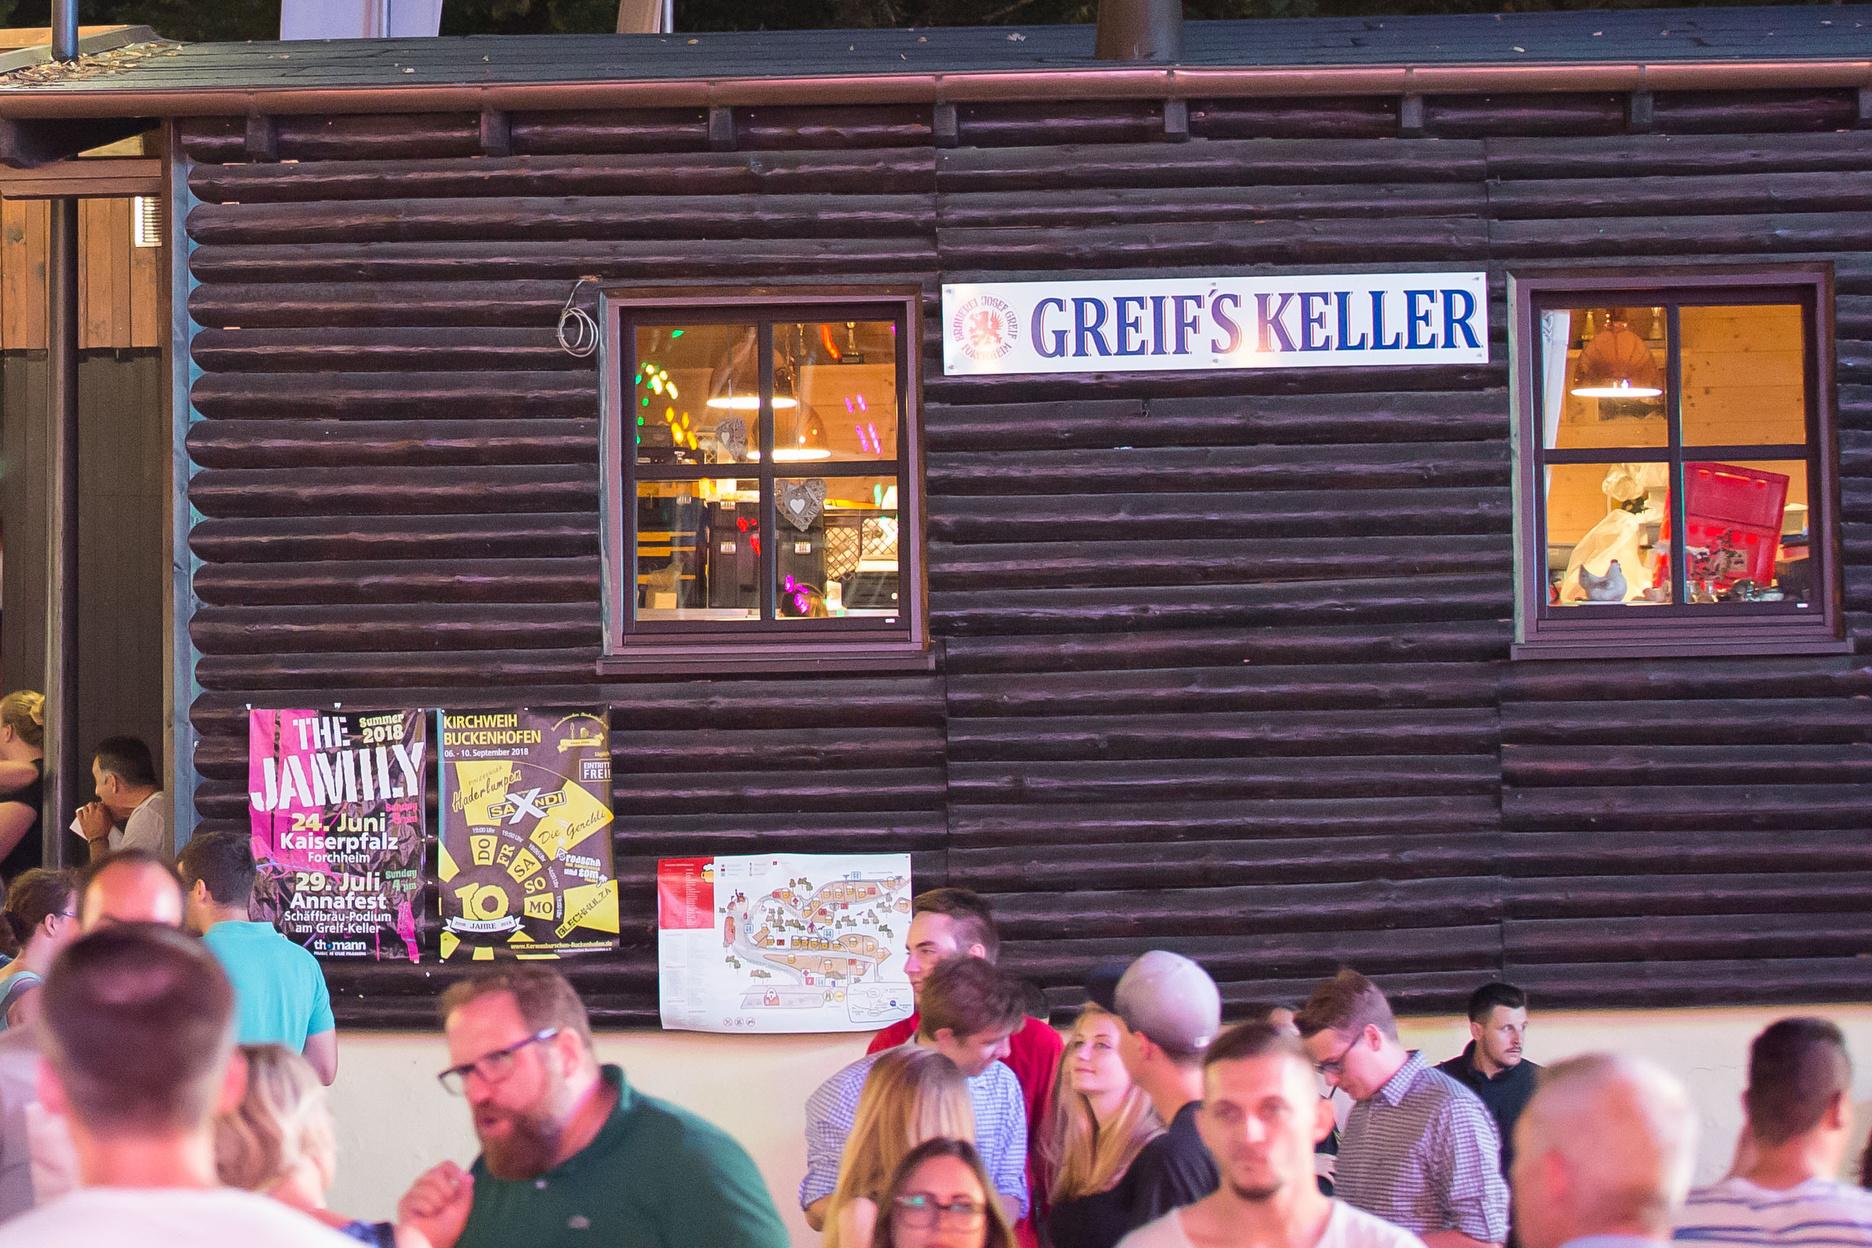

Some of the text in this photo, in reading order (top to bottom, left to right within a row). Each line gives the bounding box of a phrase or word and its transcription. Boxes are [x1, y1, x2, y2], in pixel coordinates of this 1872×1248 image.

[981, 295, 1009, 313] JOSEF
[1004, 310, 1019, 340] GREIF
[1031, 288, 1484, 360] GREIF'S KELLER
[443, 714, 518, 729] KIRCHWEIH
[293, 713, 405, 751] THE Summer
[362, 724, 404, 744] 2018
[443, 730, 542, 746] BUCKENHOFEN
[461, 749, 472, 758] 10.
[473, 747, 510, 758] September
[511, 747, 529, 756] 2018
[250, 741, 424, 812] JAMILY
[452, 769, 522, 813] Haderlumpen
[291, 812, 330, 832] 24.
[336, 812, 386, 832] Juni
[280, 831, 399, 854] Kaiserpfalz
[538, 830, 559, 845] Die
[307, 851, 371, 864] Forchheim
[478, 838, 491, 861] DO
[513, 858, 536, 878] SA
[295, 869, 418, 891] 29. Juli Sunday
[392, 879, 418, 893] 4 pm
[524, 876, 547, 894] SO
[289, 891, 388, 909] Annafest
[454, 881, 509, 921] 10
[529, 900, 553, 914] MO
[284, 910, 392, 923] Schäffbräu-Podium
[469, 922, 497, 930] JAHRE
[295, 923, 382, 934] am Greif-Keller
